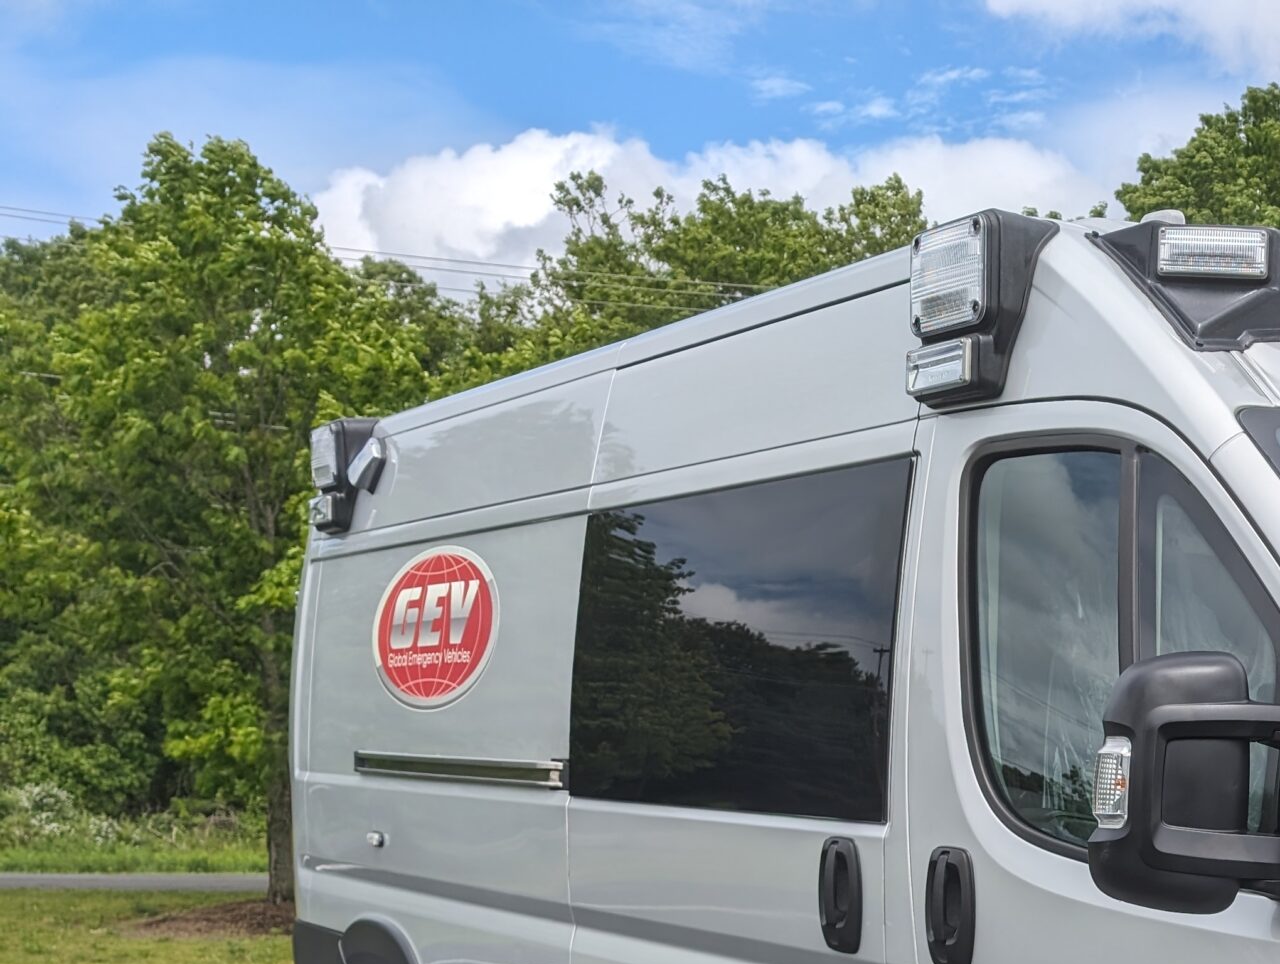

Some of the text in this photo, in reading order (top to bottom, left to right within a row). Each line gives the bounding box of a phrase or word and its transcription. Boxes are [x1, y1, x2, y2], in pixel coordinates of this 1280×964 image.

[390, 579, 480, 650] GEV
[387, 648, 471, 669] Global Emergency Vehicles
